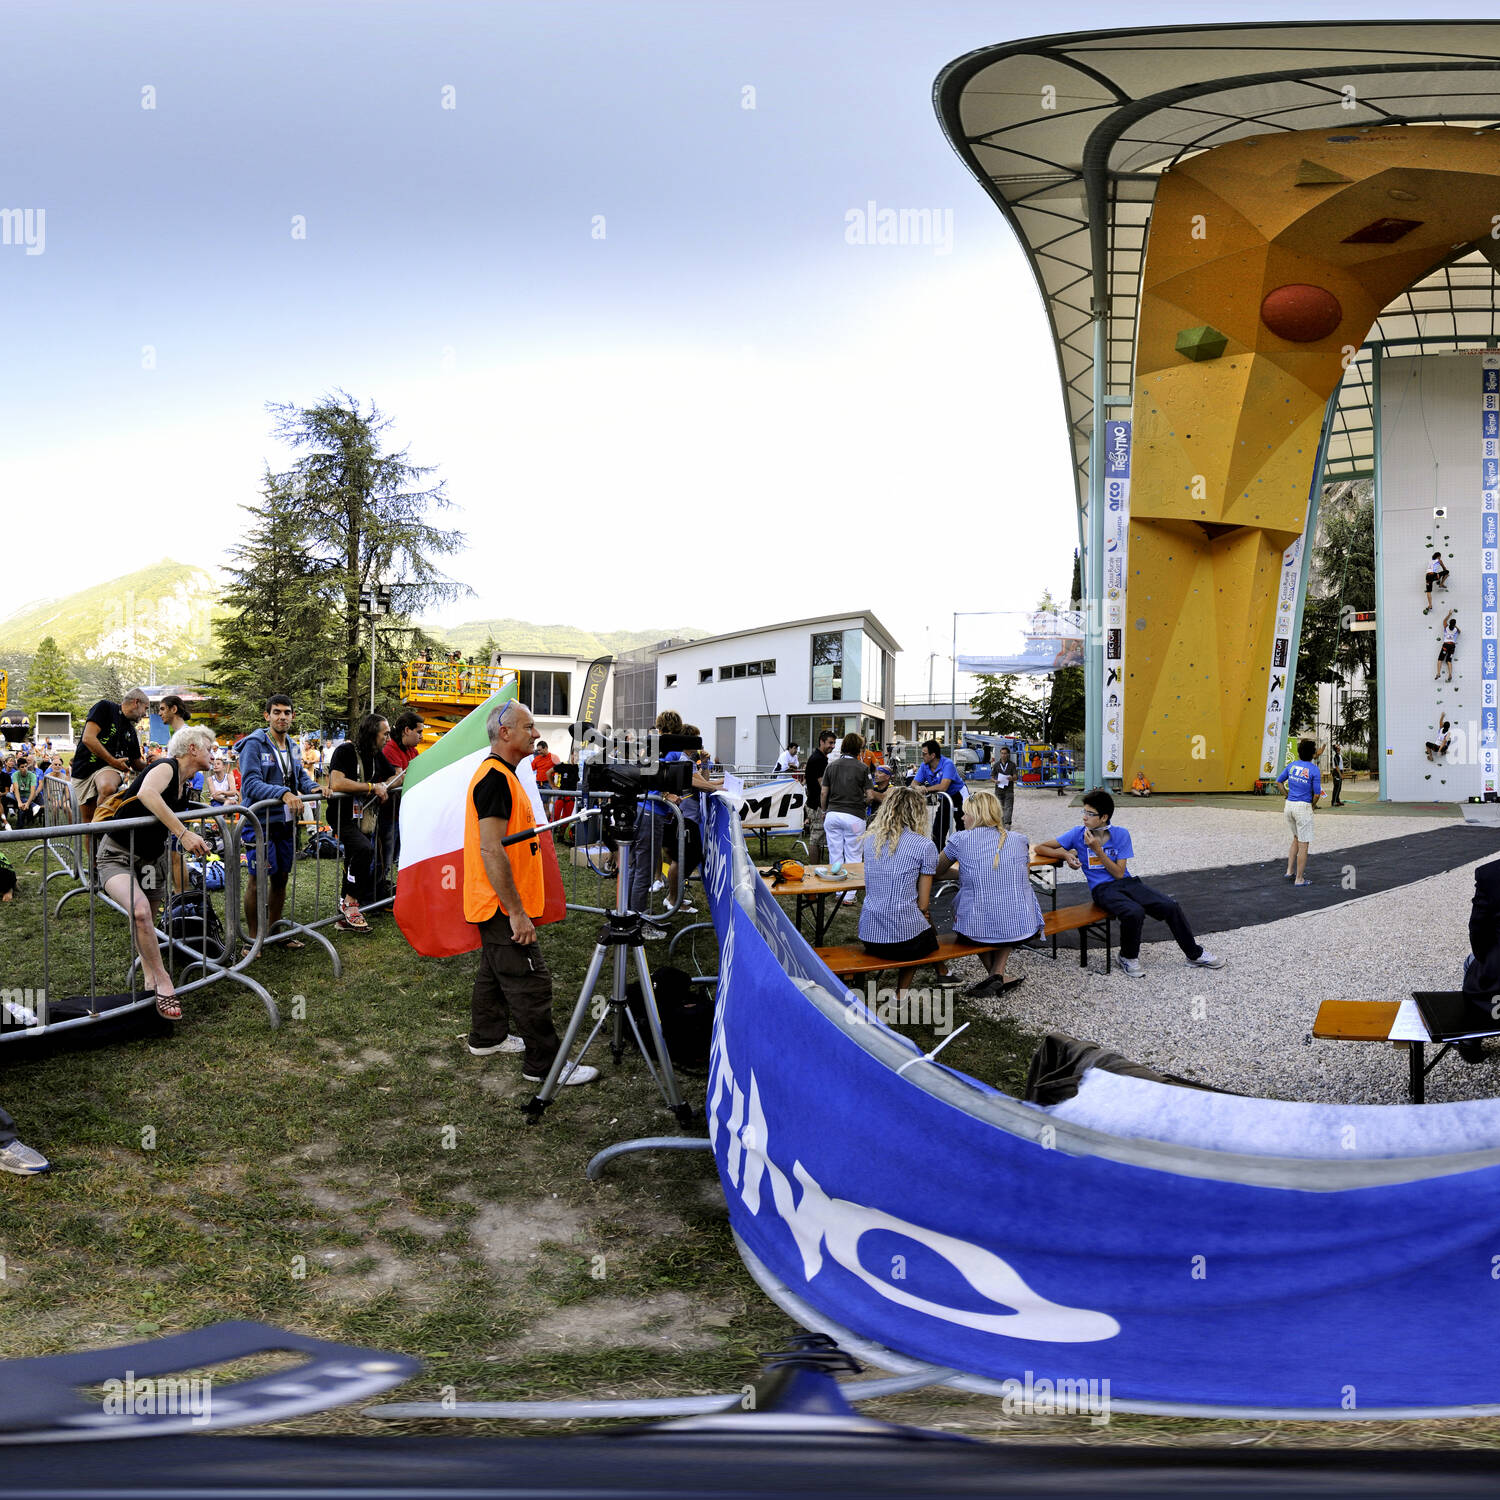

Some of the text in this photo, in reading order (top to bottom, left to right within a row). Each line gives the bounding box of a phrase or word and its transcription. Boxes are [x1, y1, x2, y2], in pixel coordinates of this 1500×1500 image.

[1487, 413, 1497, 435] TRENTINO
[1110, 426, 1128, 472] TRENTINO
[1109, 481, 1121, 512] arco
[1486, 516, 1497, 544] TRENTINO
[1485, 577, 1497, 607] TRENTINO
[1485, 643, 1497, 675] TRENTINO
[1290, 765, 1309, 779] ITA
[739, 793, 804, 821] MP
[706, 1018, 1121, 1343] TINO
